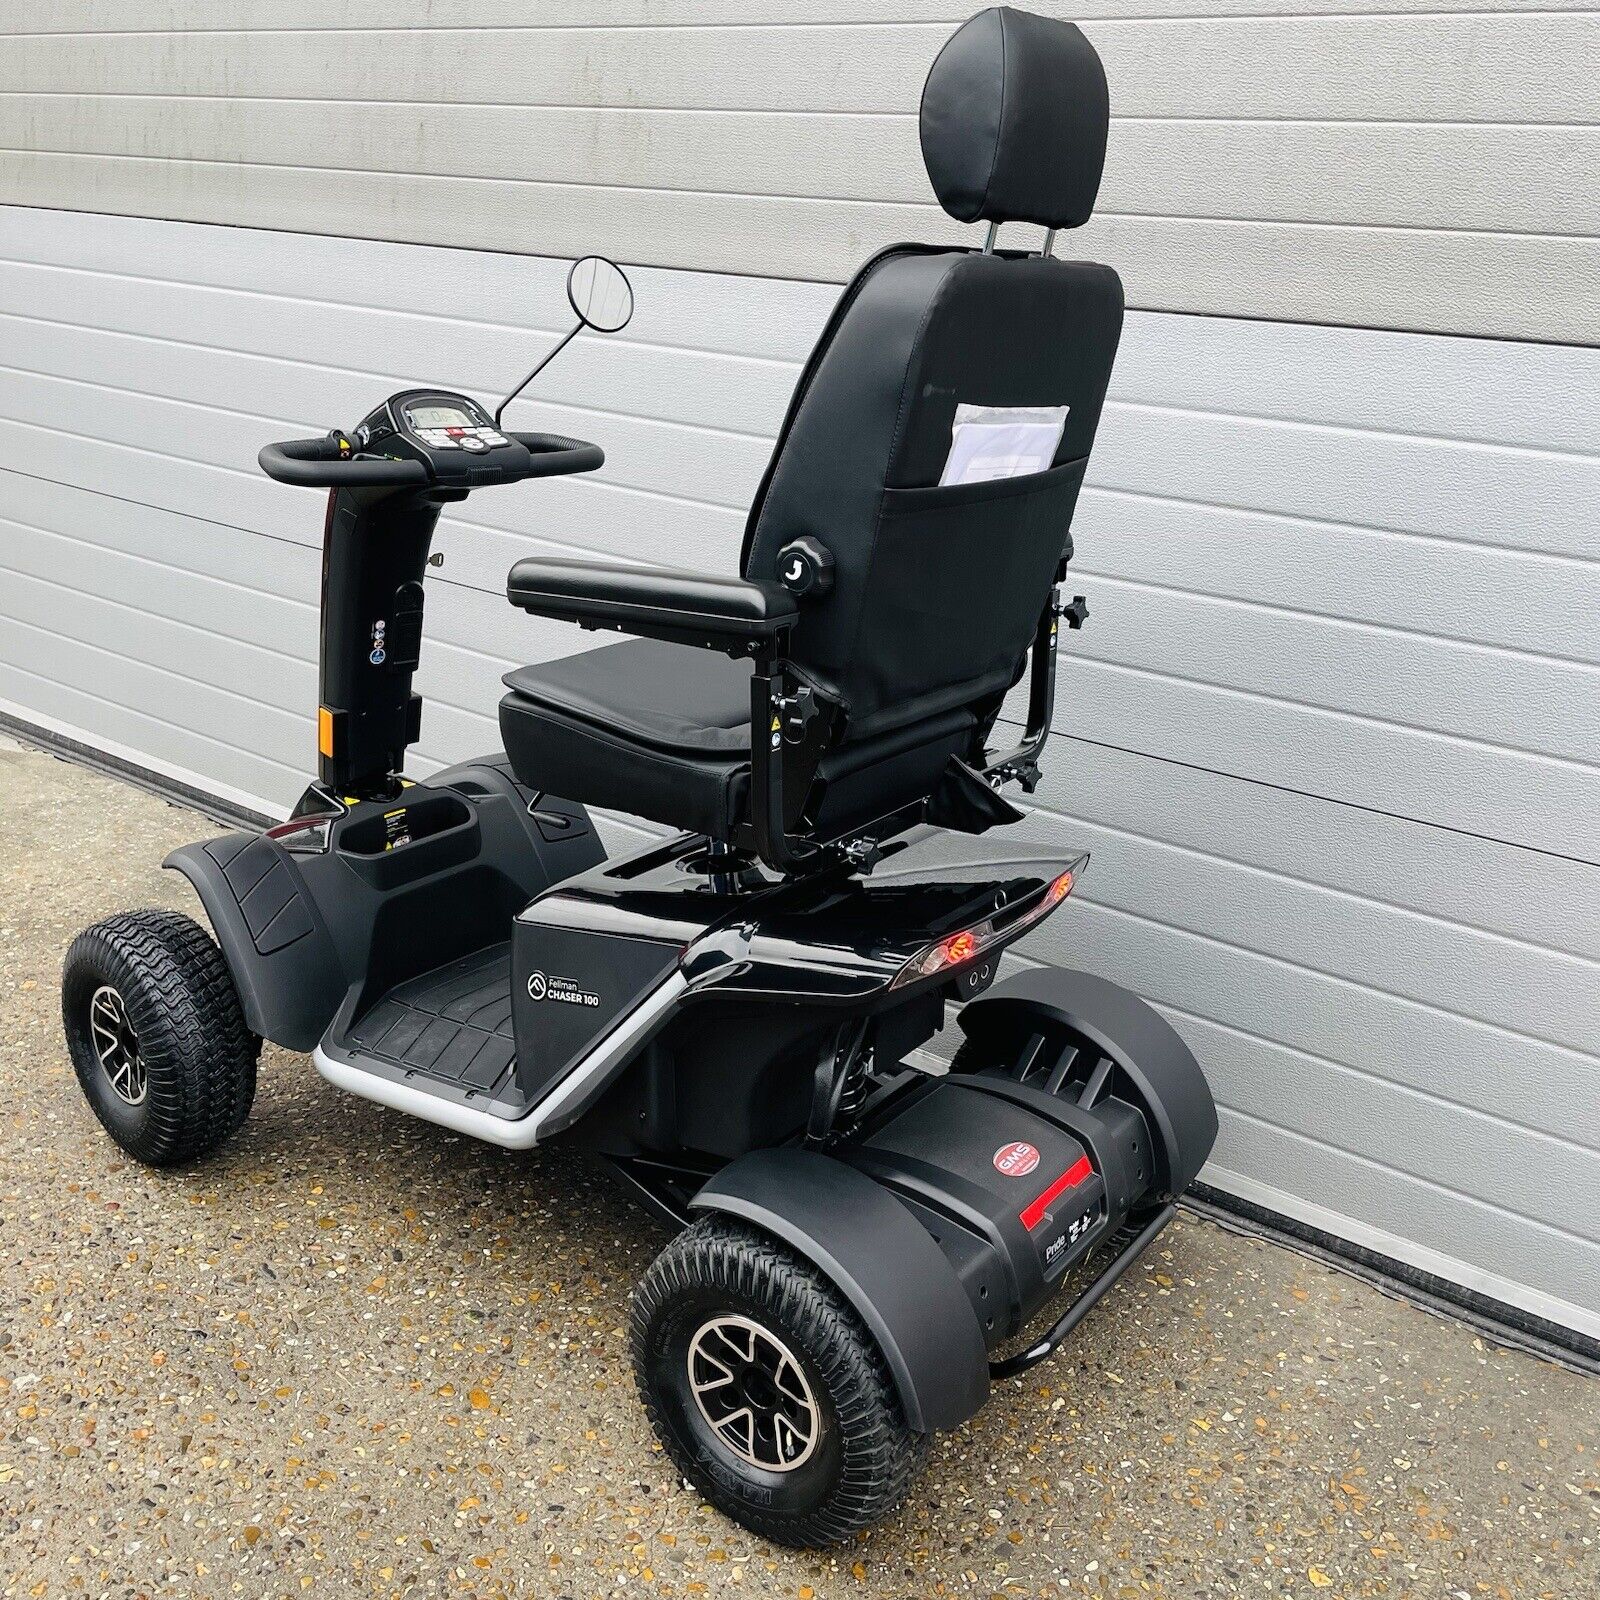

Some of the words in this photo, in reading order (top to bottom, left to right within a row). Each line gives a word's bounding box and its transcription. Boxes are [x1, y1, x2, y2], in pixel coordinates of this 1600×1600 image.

[548, 979, 577, 991] Fellman
[547, 989, 582, 1004] CHASER
[584, 995, 599, 1006] 100
[998, 1143, 1031, 1170] GMS
[1046, 1235, 1066, 1261] Pride
